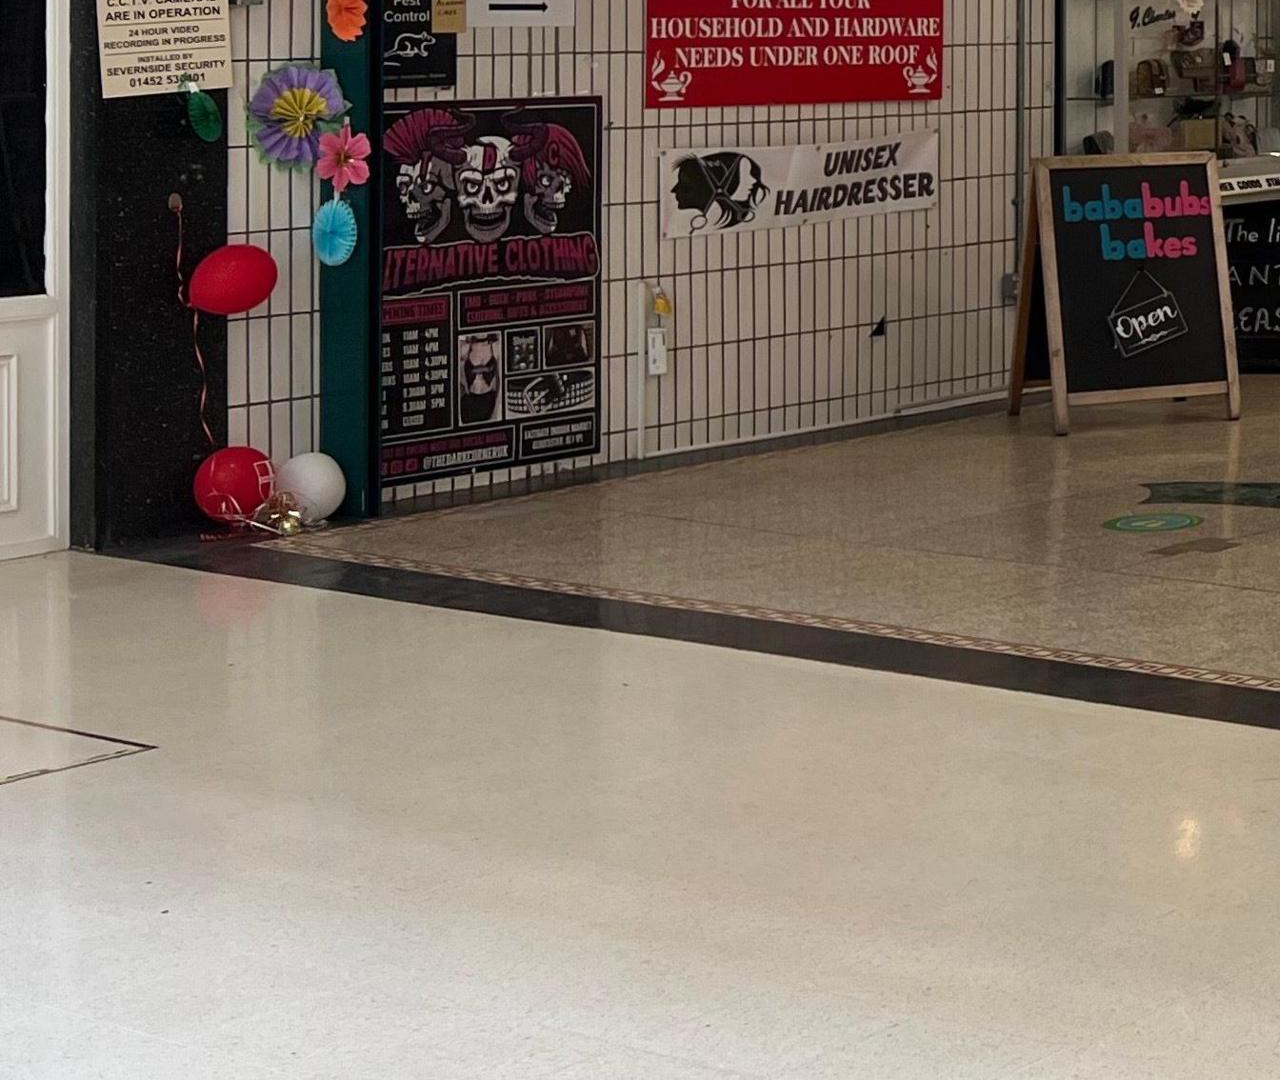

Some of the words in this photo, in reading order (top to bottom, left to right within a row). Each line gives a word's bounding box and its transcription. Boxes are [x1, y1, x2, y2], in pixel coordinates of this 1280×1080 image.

[105, 11, 130, 21] ARE
[134, 10, 145, 20] IN
[149, 6, 221, 19] OPERATION
[384, 10, 431, 23] Control
[128, 29, 139, 37] 24
[141, 27, 168, 36] HOUR
[171, 25, 200, 34] VIDEO
[651, 17, 783, 40] HOUSEHOLD
[787, 17, 829, 38] AND
[835, 17, 940, 38] HARDWARE
[103, 38, 159, 49] RECORDING
[162, 38, 171, 46] IN
[173, 34, 226, 44] PROGRESS
[106, 62, 172, 77] SEVERNSIDE
[175, 60, 226, 71] SECURITY
[138, 53, 180, 63] INSTALLED
[674, 46, 744, 70] NEEDS
[750, 46, 818, 68] UNDER
[823, 45, 864, 66] ONE
[868, 45, 920, 66] ROOF
[129, 76, 163, 88] 01452
[824, 142, 902, 178] UNISEX
[774, 172, 935, 217] HAIRDRESSER
[1063, 181, 1210, 223] bababubs
[1100, 221, 1198, 261] bakes
[1227, 219, 1259, 244] The
[383, 242, 499, 291] LTERNATIVE
[504, 235, 595, 271] CLOTHING
[1115, 301, 1179, 339] Open
